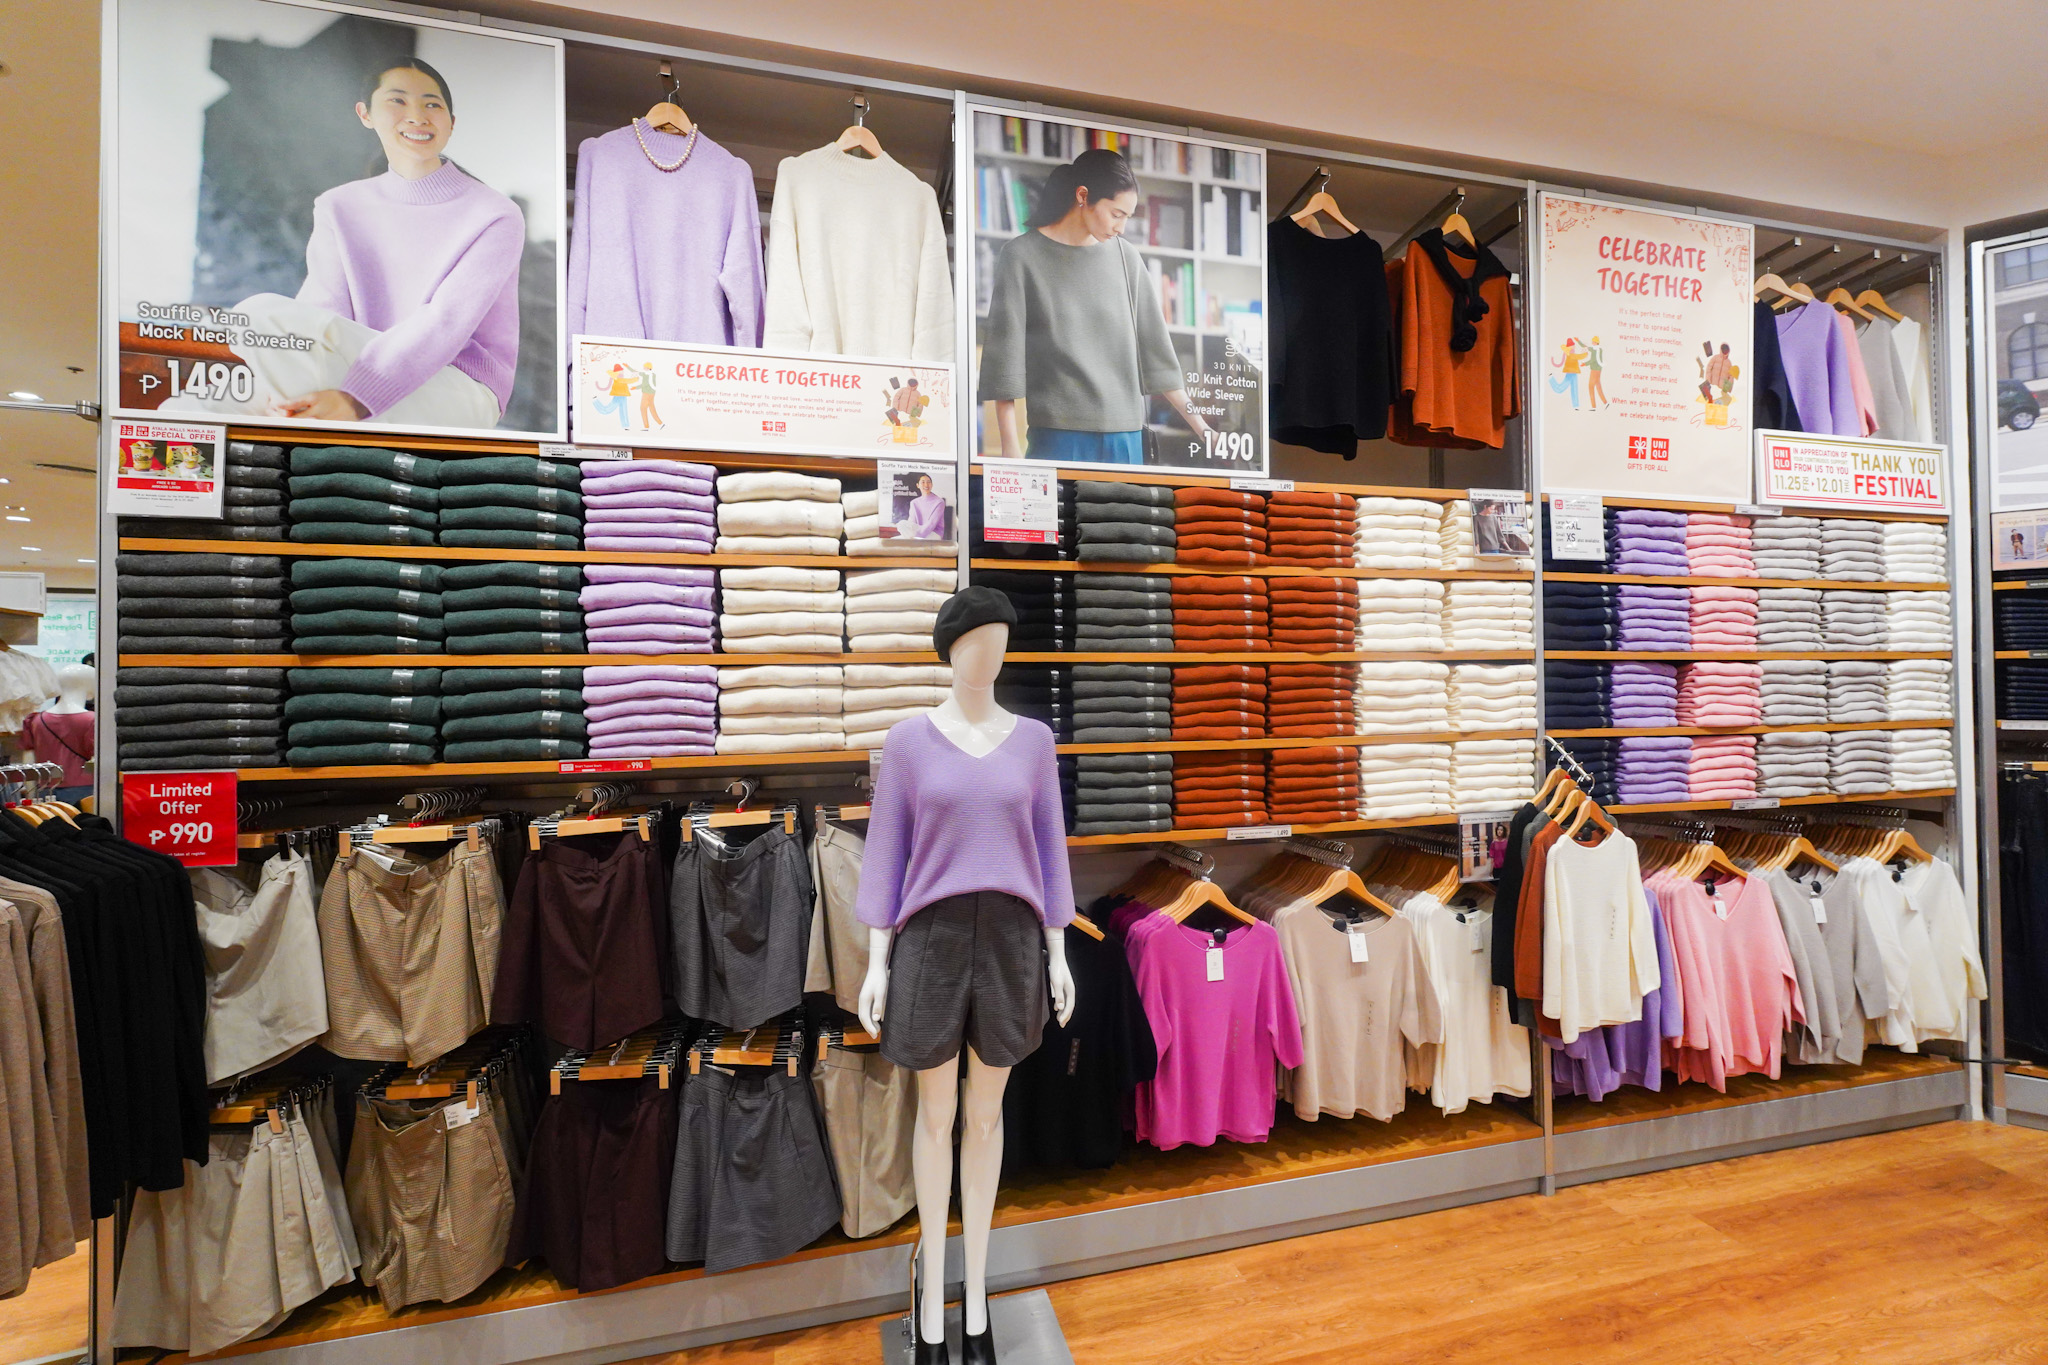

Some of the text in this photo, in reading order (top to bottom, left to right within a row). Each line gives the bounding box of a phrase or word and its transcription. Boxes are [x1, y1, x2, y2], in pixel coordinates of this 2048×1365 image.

[1599, 236, 1706, 272] CELEBRATE
[1597, 268, 1702, 302] TOGETHER
[138, 302, 249, 326] Souffle Yarn
[139, 322, 314, 351] Mock Neck Sweater
[1214, 362, 1252, 372] 3D KNIT
[676, 363, 862, 389] CELEBRATE TOGETHER
[1186, 372, 1257, 388] 3D Knit Cotton
[1186, 387, 1244, 401] Wide Sleeve
[1186, 403, 1225, 416] Sweater
[1630, 412, 1654, 420] celebrate
[151, 431, 186, 439] SPECIAL
[1653, 440, 1666, 449] UNI
[1653, 450, 1667, 459] QLO
[1774, 449, 1788, 458] UNI
[1801, 449, 1839, 457] APPRECIATION
[1775, 459, 1790, 468] QLO
[1794, 463, 1812, 472] FROM
[1826, 466, 1833, 474] TO
[1837, 466, 1848, 475] YOU
[1851, 452, 1936, 475] THANK YOU
[1775, 475, 1801, 490] 11.25
[1817, 477, 1843, 493] 12.01
[1854, 474, 1937, 499] FESTIVAL
[990, 486, 1023, 494] COLLECT
[1566, 533, 1575, 542] XS
[150, 782, 212, 798] Limited
[160, 800, 202, 815] Offer
